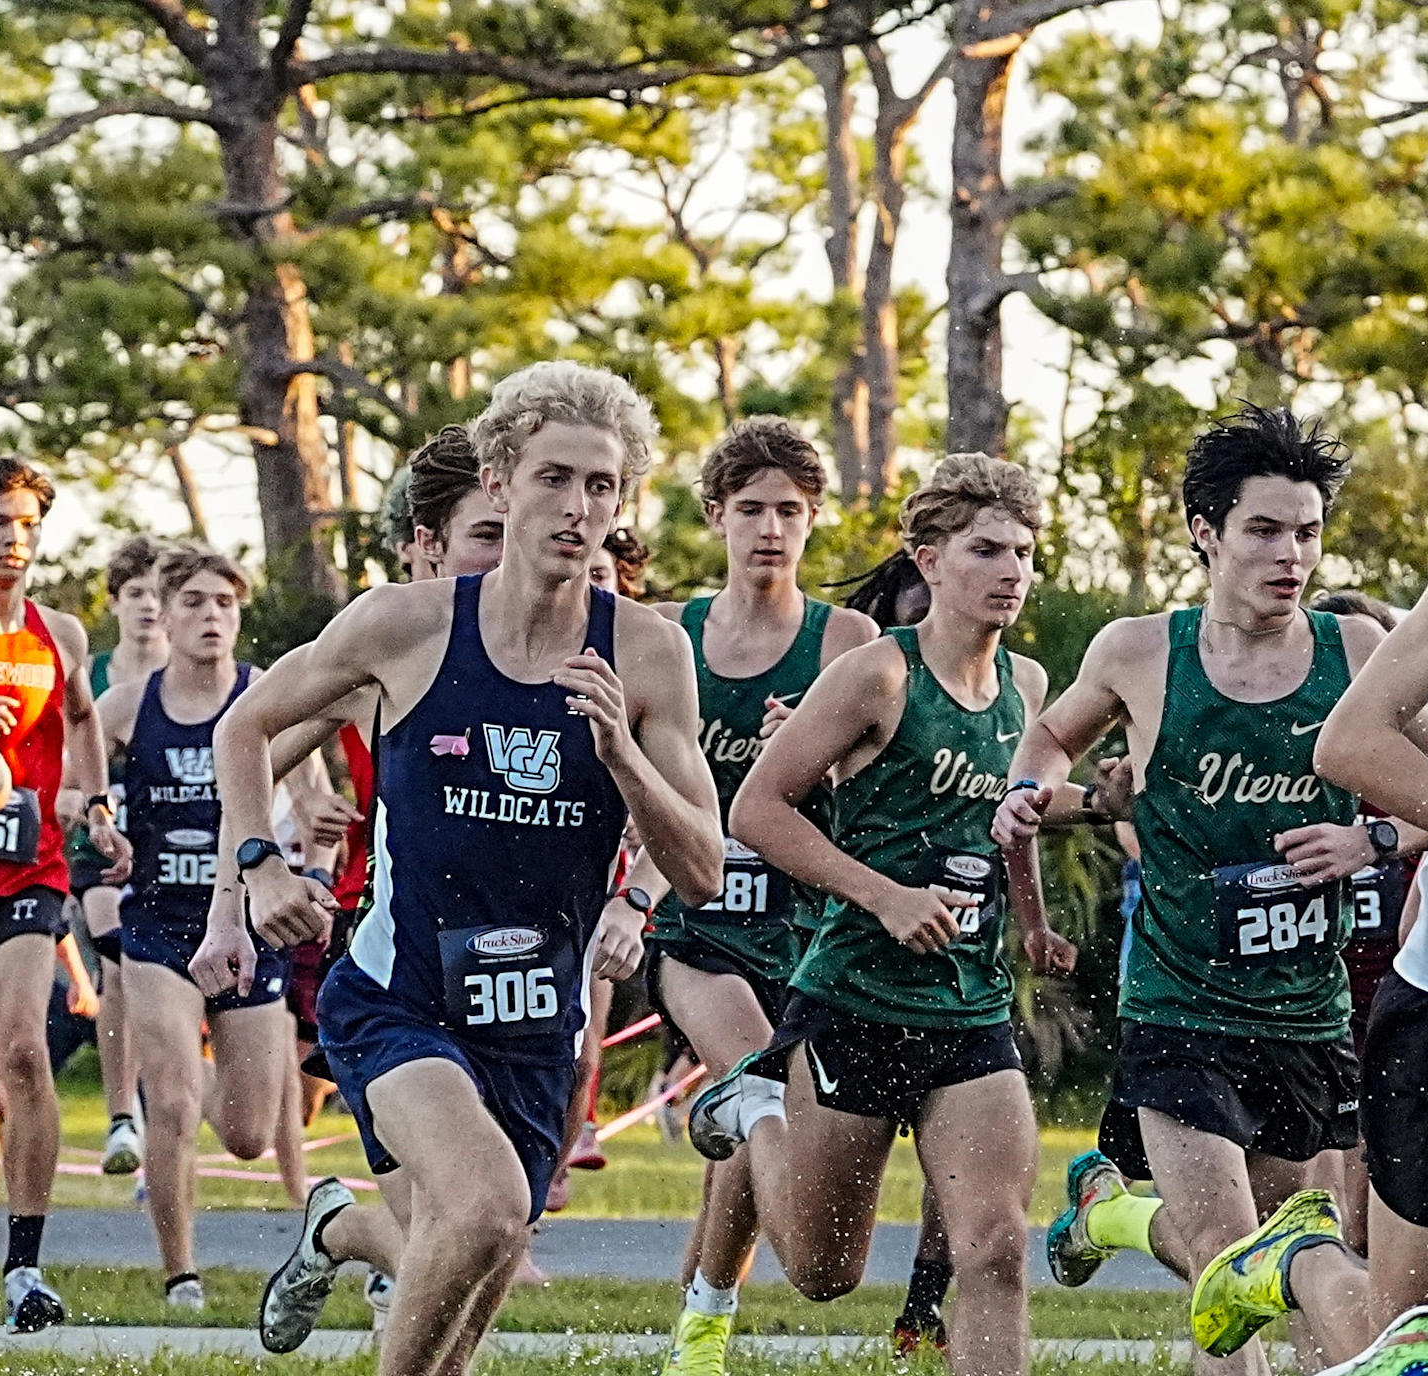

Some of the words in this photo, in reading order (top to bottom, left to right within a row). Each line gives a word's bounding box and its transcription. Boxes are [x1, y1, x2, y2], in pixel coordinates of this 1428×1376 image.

[930, 748, 1007, 802] Viera
[1197, 752, 1321, 804] Viera
[443, 785, 586, 827] WILDCATS
[158, 852, 218, 885] 302
[476, 935, 509, 950] Track
[510, 929, 544, 947] Shack
[1237, 896, 1329, 956] 284
[464, 966, 558, 1026] 306
